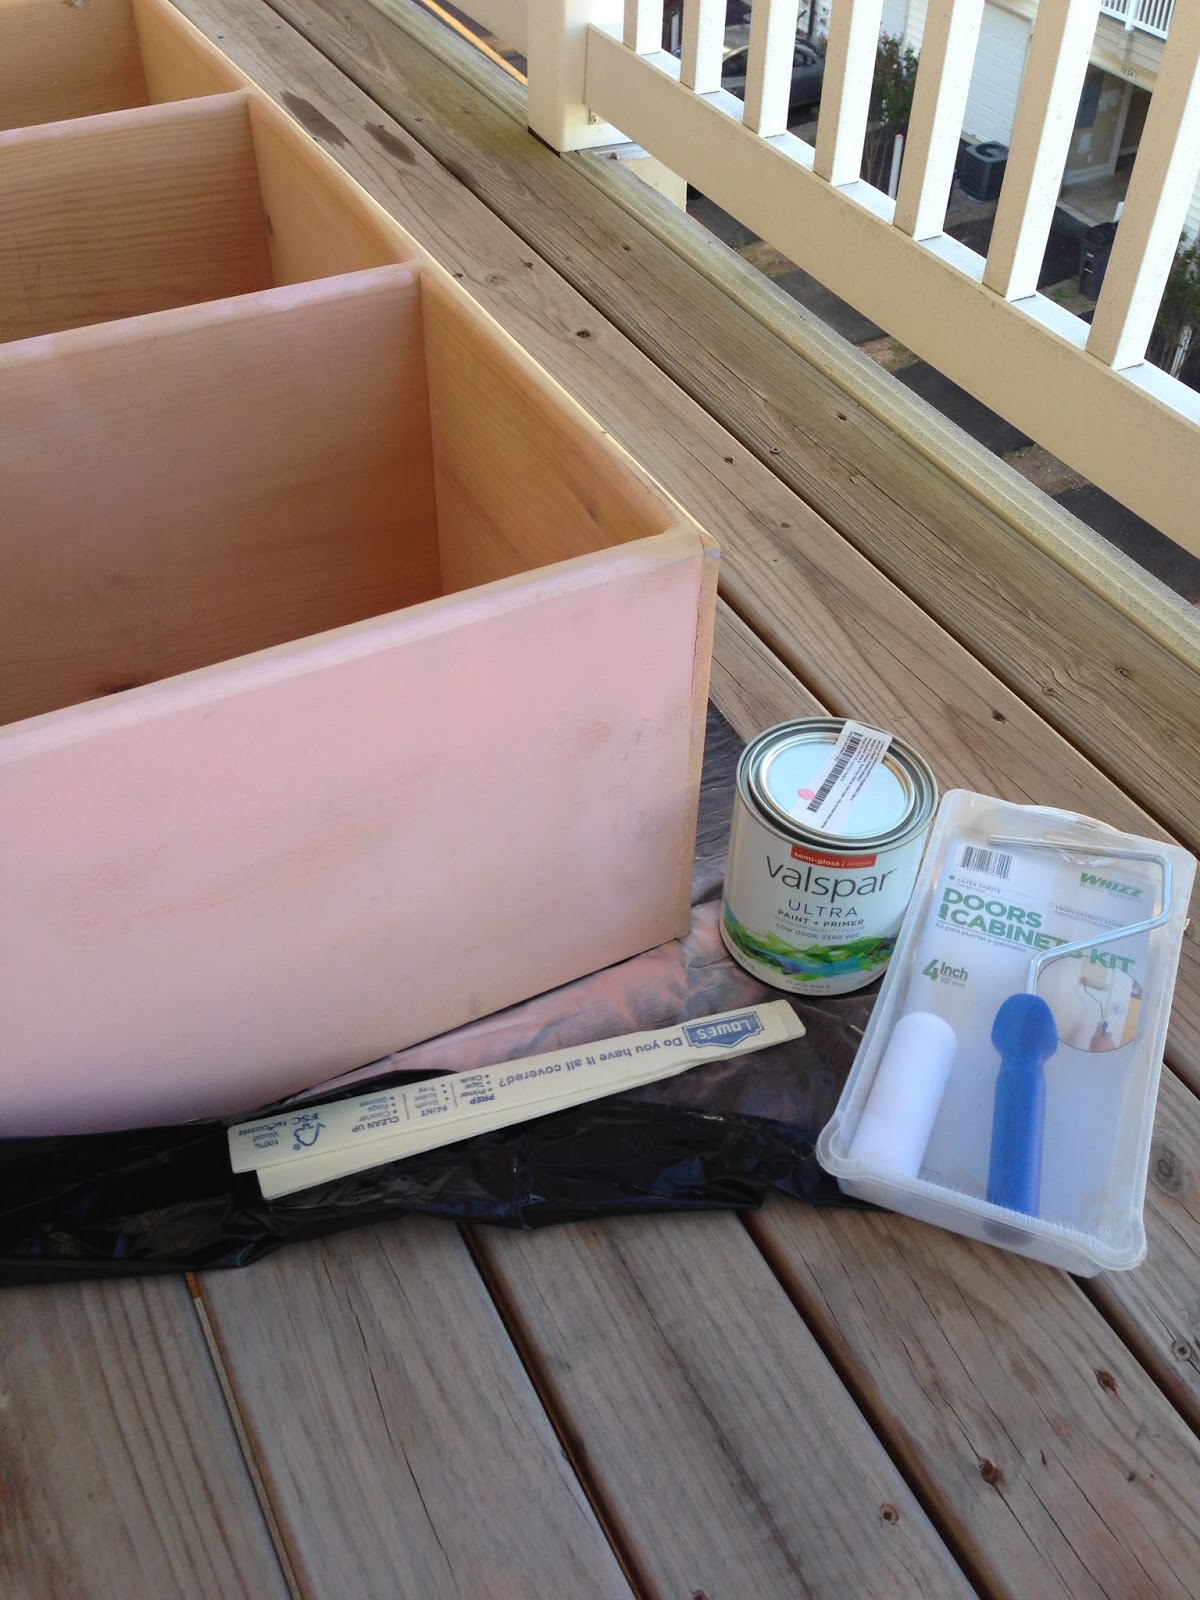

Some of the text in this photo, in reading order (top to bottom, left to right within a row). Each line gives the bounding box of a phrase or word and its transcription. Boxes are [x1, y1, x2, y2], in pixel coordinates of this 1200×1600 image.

[794, 852, 840, 866] semi-gloss
[766, 855, 893, 903] valspar
[1080, 872, 1143, 897] WHIZZ
[788, 899, 857, 917] ULTRA
[942, 887, 1042, 928] DOORS
[778, 909, 810, 924] PAINT
[824, 919, 864, 927] PRIMER
[776, 923, 792, 934] LOW
[796, 930, 820, 940] ODOR,
[936, 923, 944, 931] Kit
[945, 925, 960, 935] para
[962, 929, 986, 942] puertas
[994, 938, 1027, 954] gabinetes
[1090, 948, 1136, 973] KIT
[923, 959, 969, 982] 4 Inch
[940, 977, 951, 985] 102
[696, 1018, 751, 1039] LOWE'S
[498, 1037, 683, 1087] Do you have it all covered?
[459, 1074, 482, 1084] Caulk
[465, 1081, 484, 1090] Tape
[414, 1092, 437, 1102] Roller
[460, 1088, 486, 1099] Primer
[469, 1094, 495, 1105] PREP
[359, 1096, 387, 1108] Gloves
[367, 1103, 389, 1113] Rags
[359, 1111, 390, 1123] Cleaner
[420, 1105, 447, 1117] PAINT
[292, 1112, 319, 1126] FSC
[351, 1116, 399, 1133] CLEAN UP
[253, 1131, 279, 1142] Wood
[254, 1138, 279, 1149] 100%
